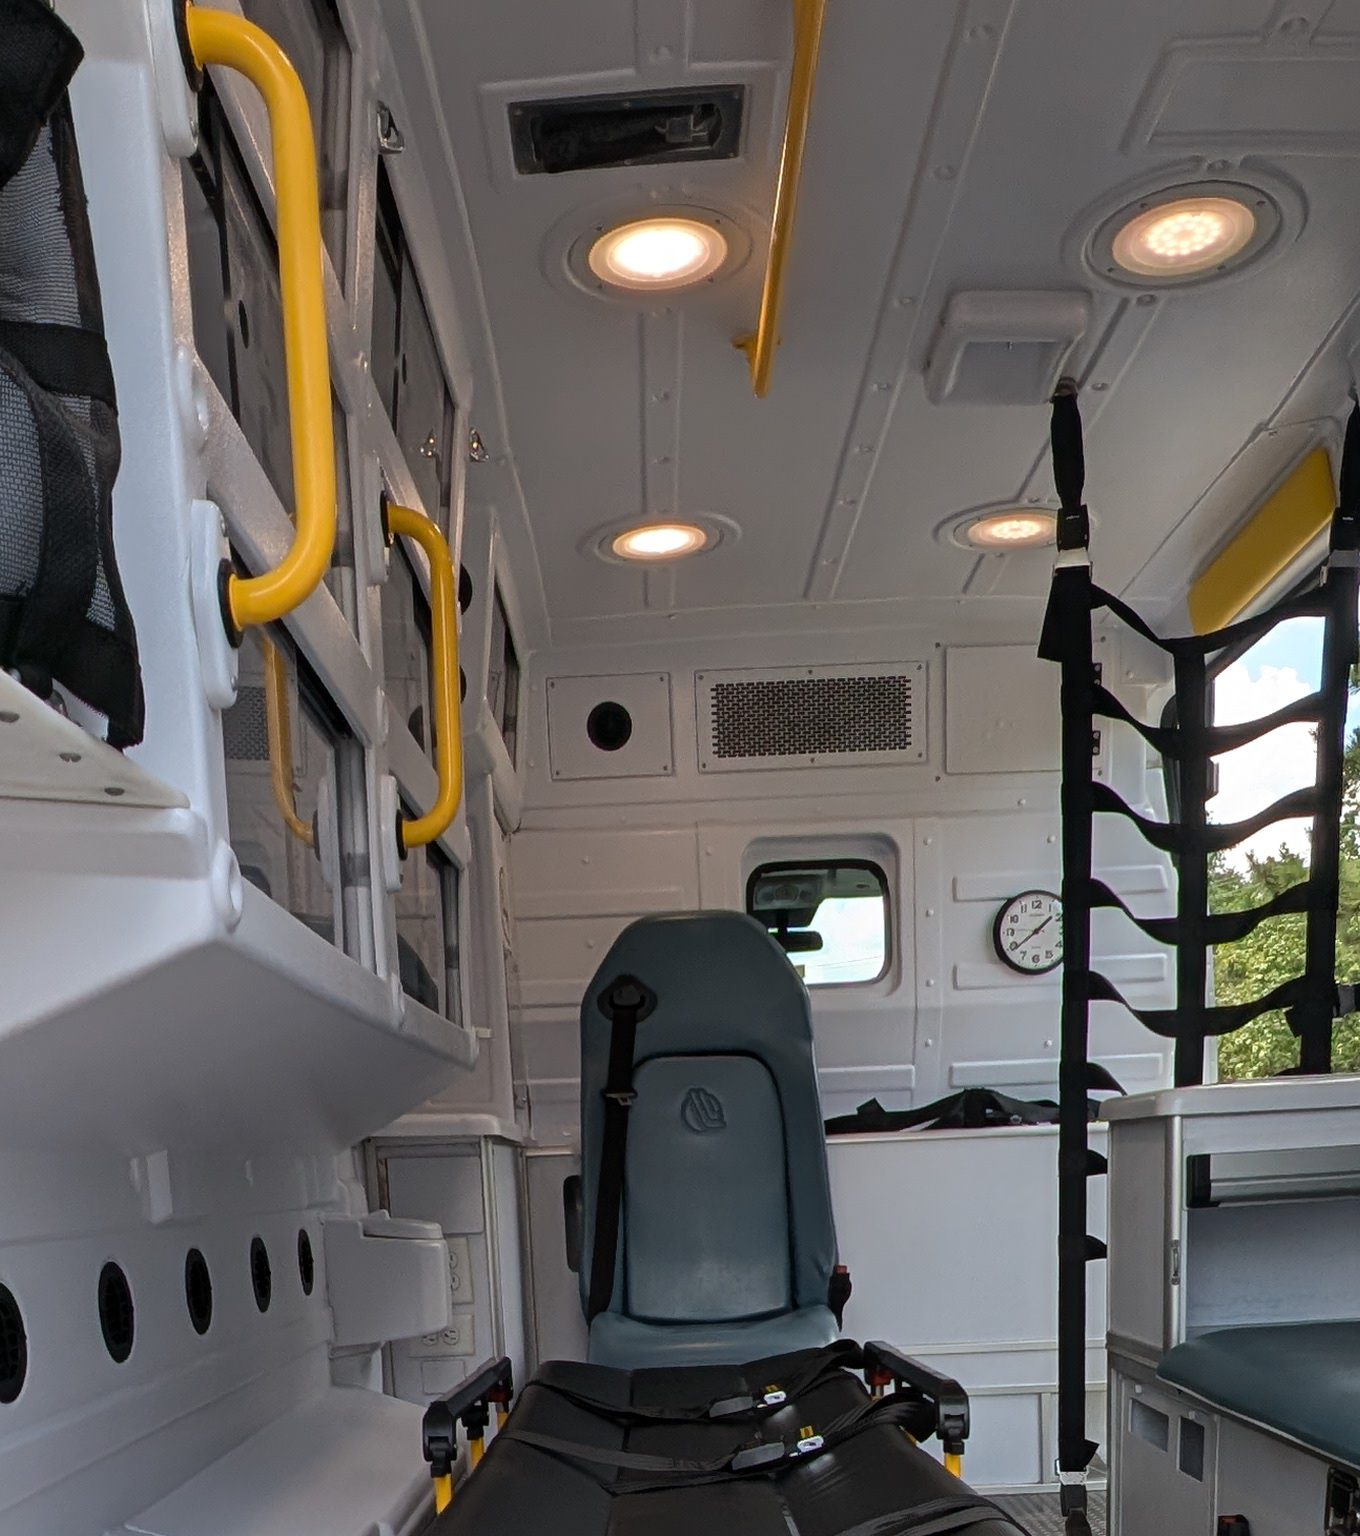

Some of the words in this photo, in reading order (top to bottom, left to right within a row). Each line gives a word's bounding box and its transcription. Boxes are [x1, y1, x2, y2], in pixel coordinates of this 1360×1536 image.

[1020, 903, 1028, 914] 11
[1031, 899, 1042, 910] 12
[1009, 914, 1019, 924] 10
[1019, 950, 1027, 961] 7
[1031, 954, 1041, 964] 6
